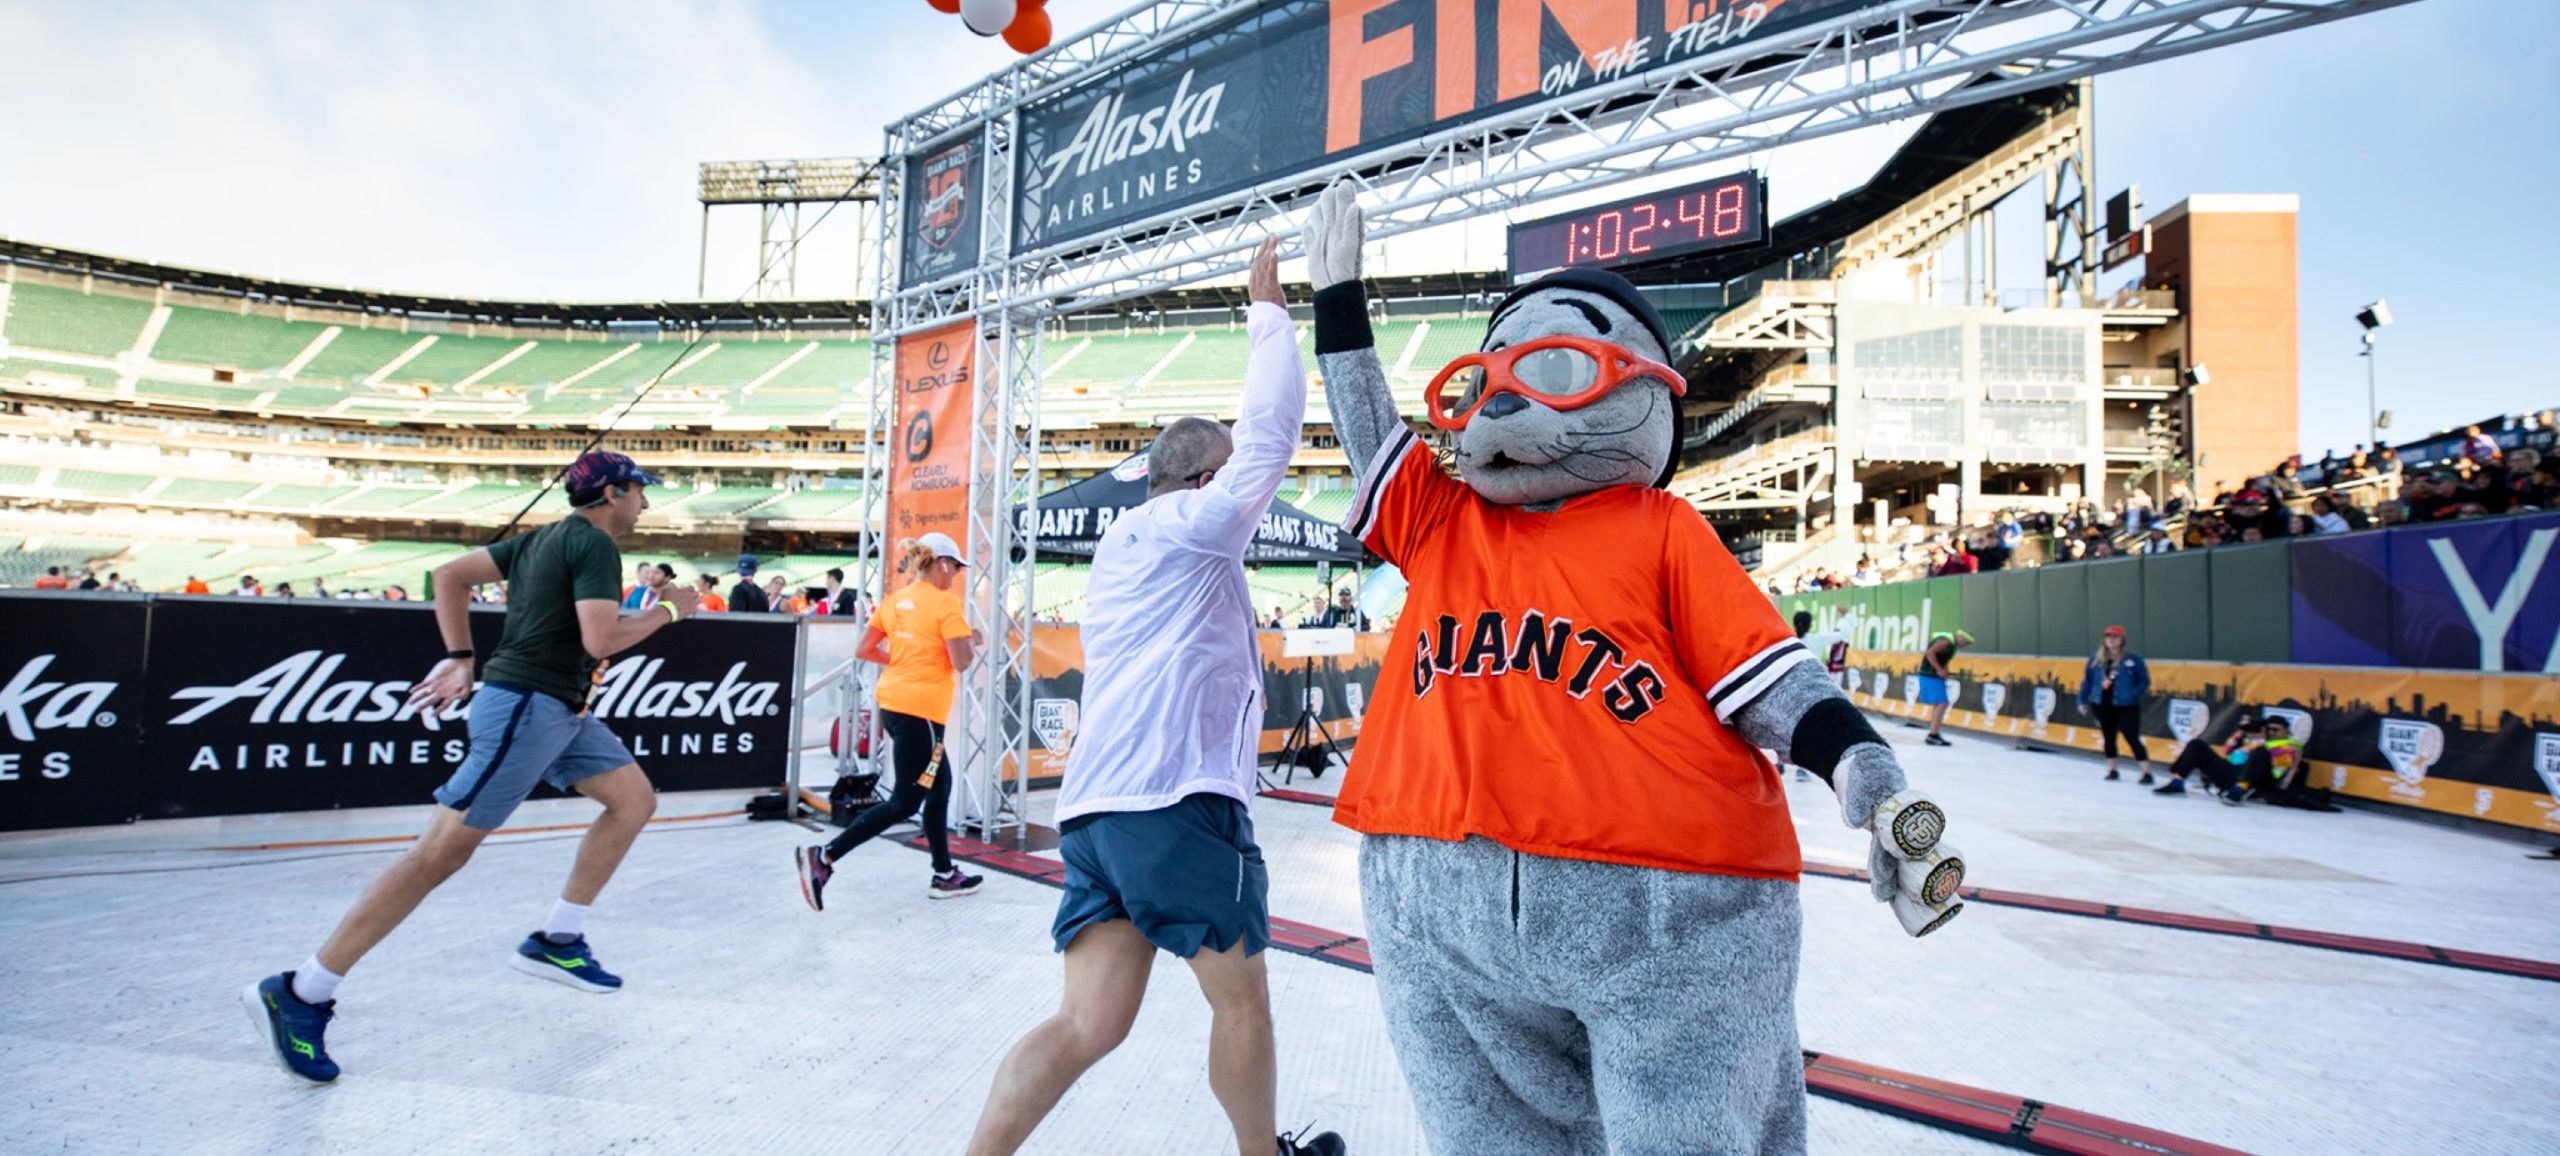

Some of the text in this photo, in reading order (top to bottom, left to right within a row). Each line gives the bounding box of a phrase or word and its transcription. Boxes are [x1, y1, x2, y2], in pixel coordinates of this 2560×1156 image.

[1541, 2, 1768, 96] ON THE FIELD
[1042, 69, 1226, 190] Alaska
[1047, 157, 1202, 228] AIRLINES
[905, 366, 969, 393] LEXUS
[911, 476, 961, 492] KOMBUCHA
[912, 464, 950, 479] CLEARLY
[915, 512, 961, 526] Dignity Health
[1018, 506, 1090, 538] GIANT
[1258, 512, 1301, 545] GIANT
[1304, 520, 1339, 552] RACE
[2427, 527, 2560, 674] Y
[1818, 598, 1932, 653] Ntional
[1413, 608, 1668, 725] GIANTS
[593, 655, 780, 726] Alaska
[1040, 706, 1063, 718] GIANT
[1040, 719, 1064, 731] RACE
[188, 738, 465, 771] AIRLINES
[617, 732, 754, 756] LINES
